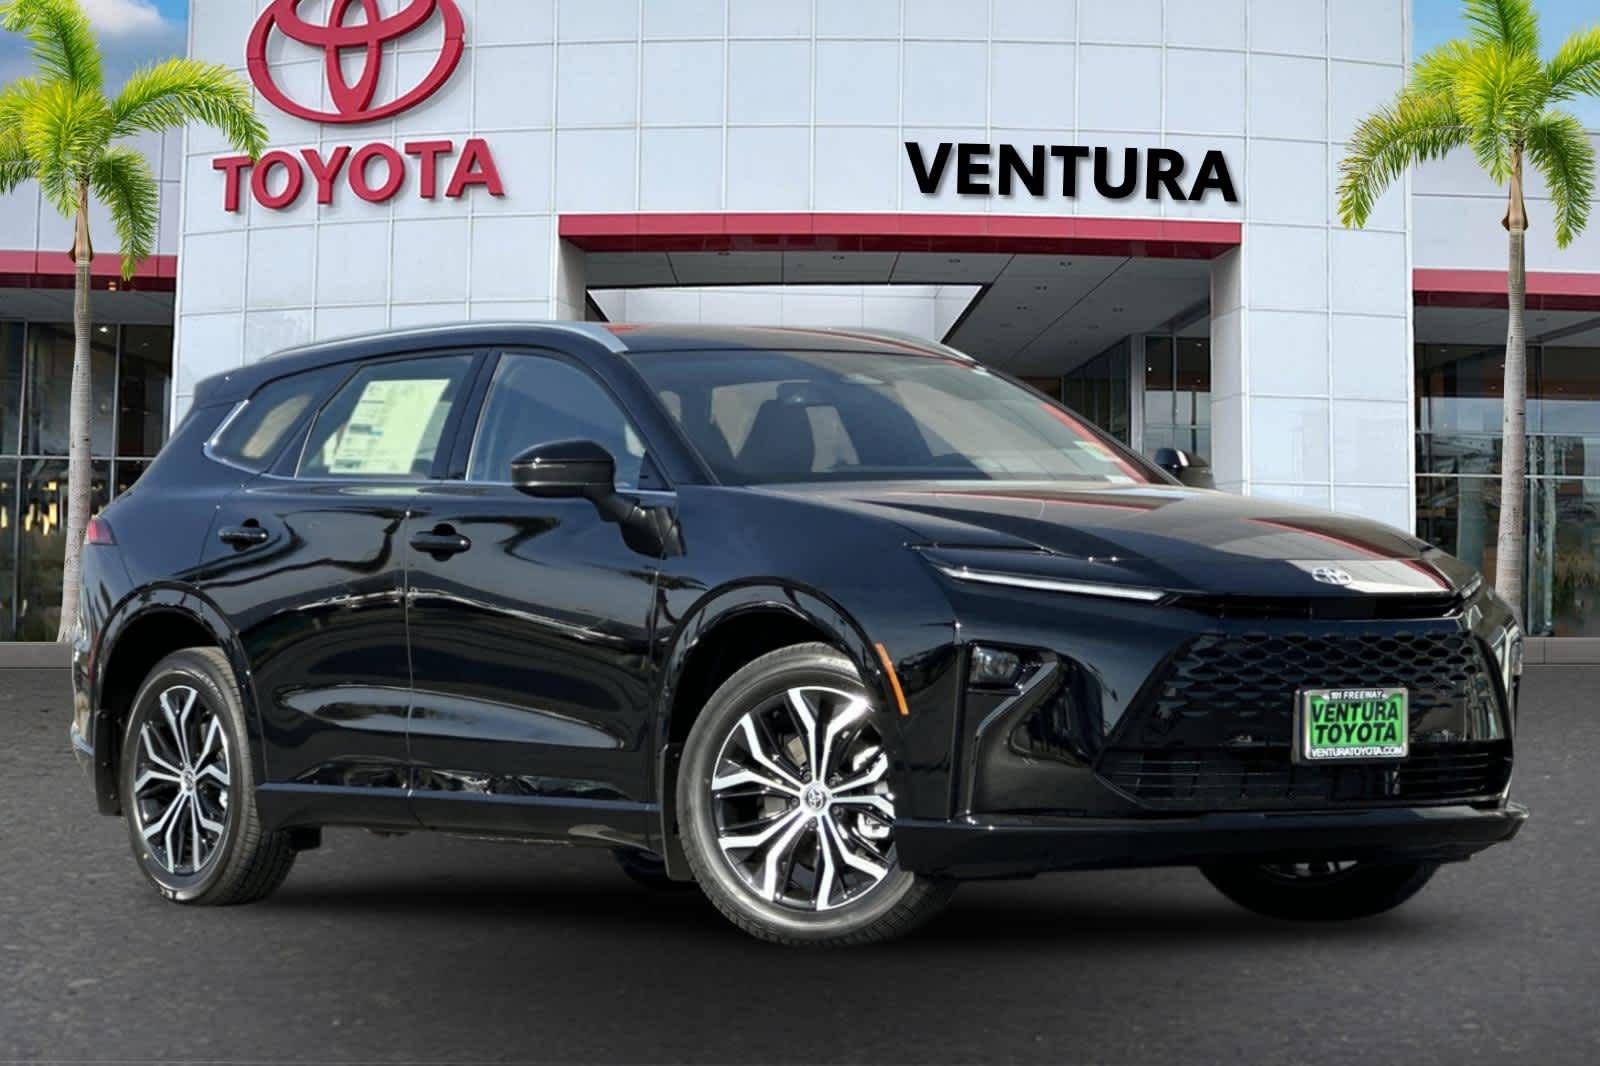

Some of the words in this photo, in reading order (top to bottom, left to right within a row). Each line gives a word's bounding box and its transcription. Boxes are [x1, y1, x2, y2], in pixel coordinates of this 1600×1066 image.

[213, 138, 505, 212] TOYOTA
[904, 141, 1238, 203] VENTURA
[1343, 691, 1382, 699] FREEWAY
[1312, 702, 1398, 722] VENTURA
[1315, 723, 1397, 744] TOYOTA
